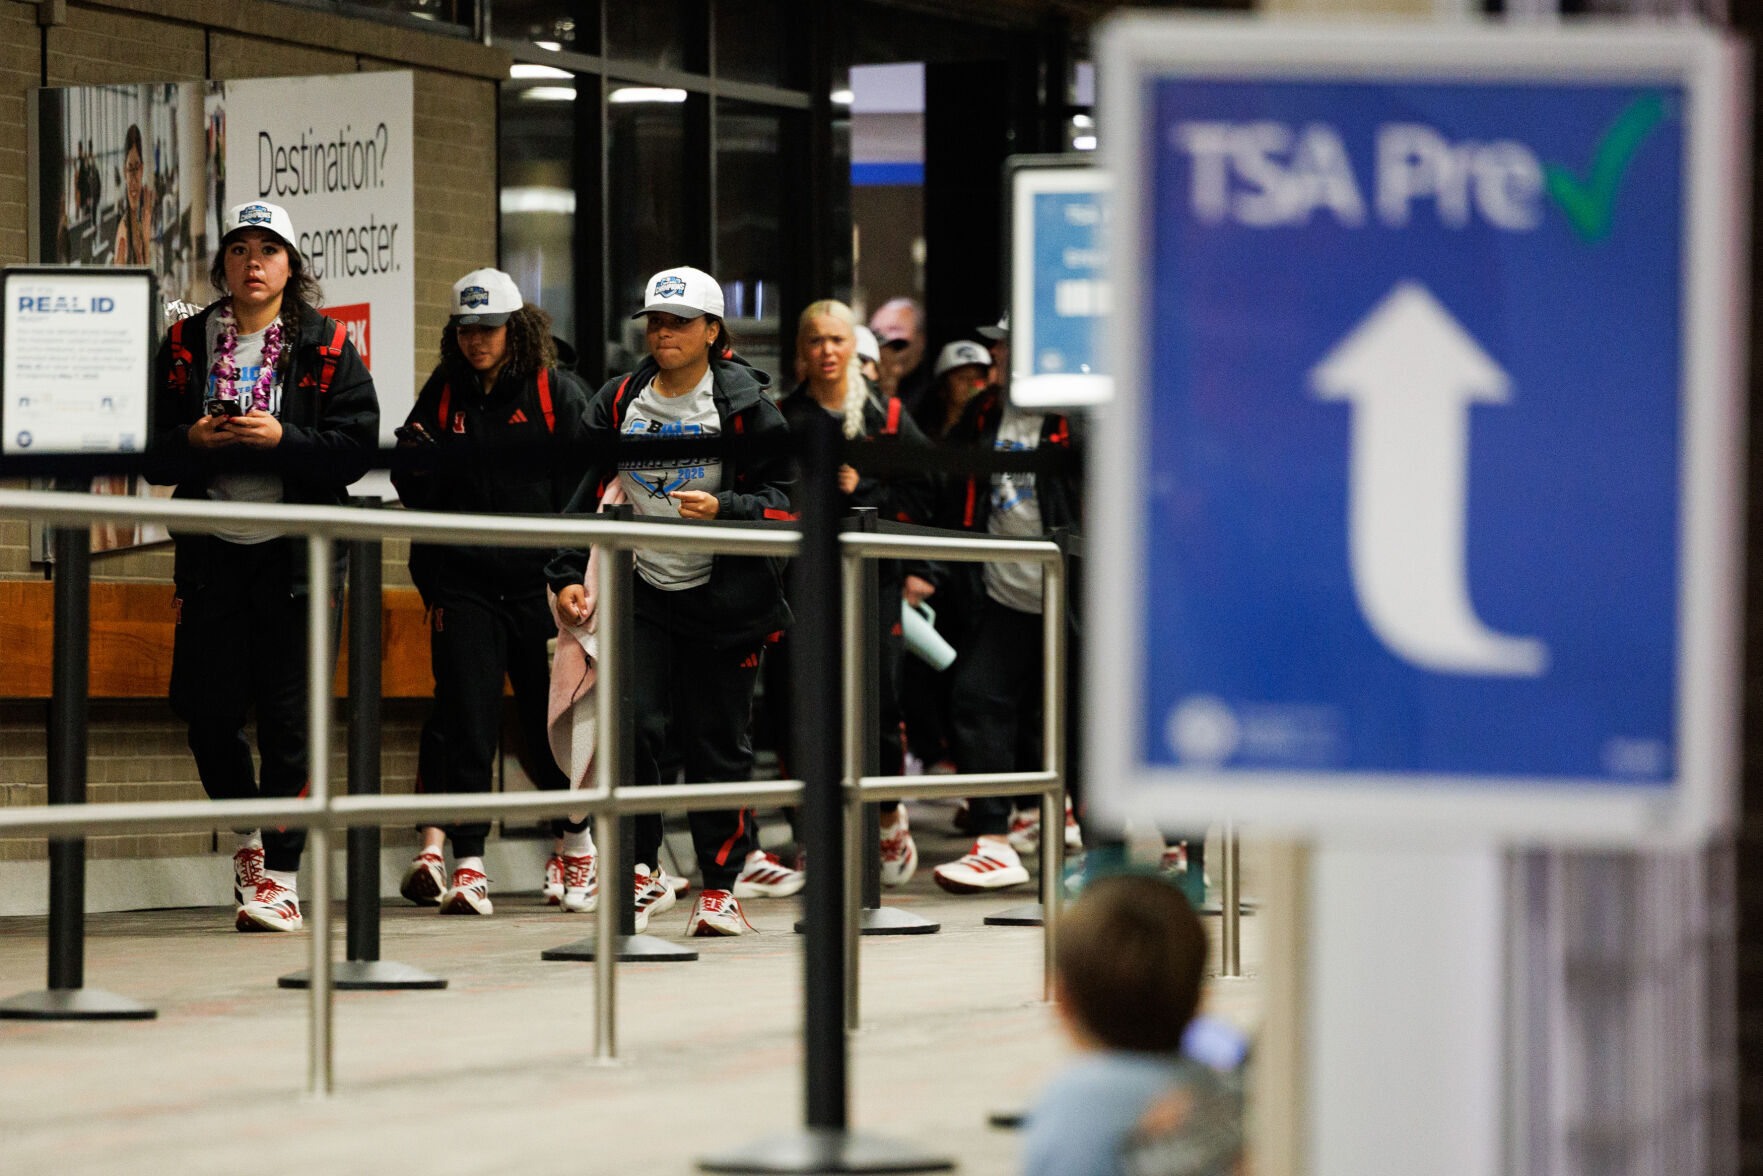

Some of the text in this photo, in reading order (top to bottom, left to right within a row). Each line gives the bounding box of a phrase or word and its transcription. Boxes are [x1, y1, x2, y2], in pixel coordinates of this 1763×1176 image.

[258, 122, 389, 198] Destination?
[1172, 101, 1544, 231] TSA Pre
[300, 213, 400, 280] semester.
[18, 296, 115, 313] REAL ID
[346, 319, 368, 357] RK
[677, 466, 705, 481] 2026
